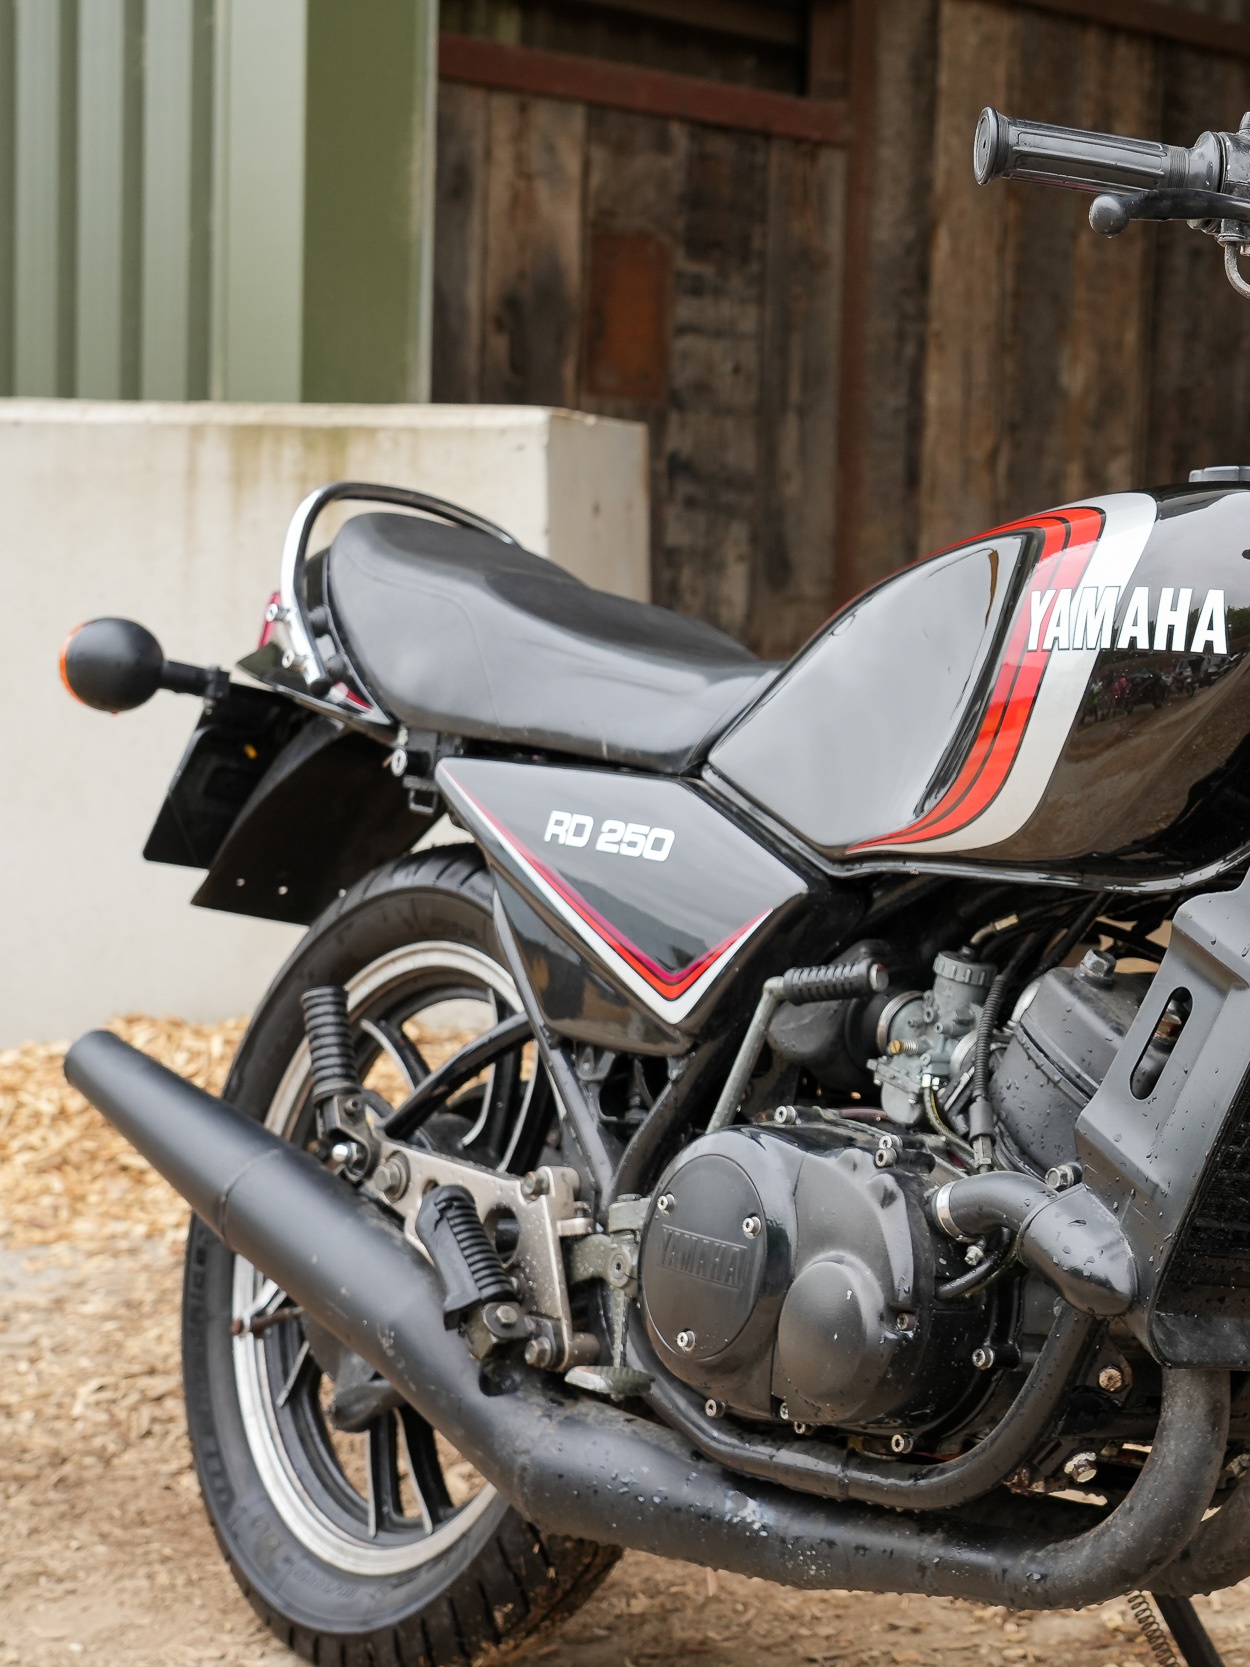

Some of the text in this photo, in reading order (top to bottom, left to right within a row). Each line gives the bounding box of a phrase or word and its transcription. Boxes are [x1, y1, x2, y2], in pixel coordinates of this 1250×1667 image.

[1027, 586, 1228, 654] YAMAHA
[544, 810, 675, 862] RD 250
[660, 1228, 744, 1287] YAMAHA
